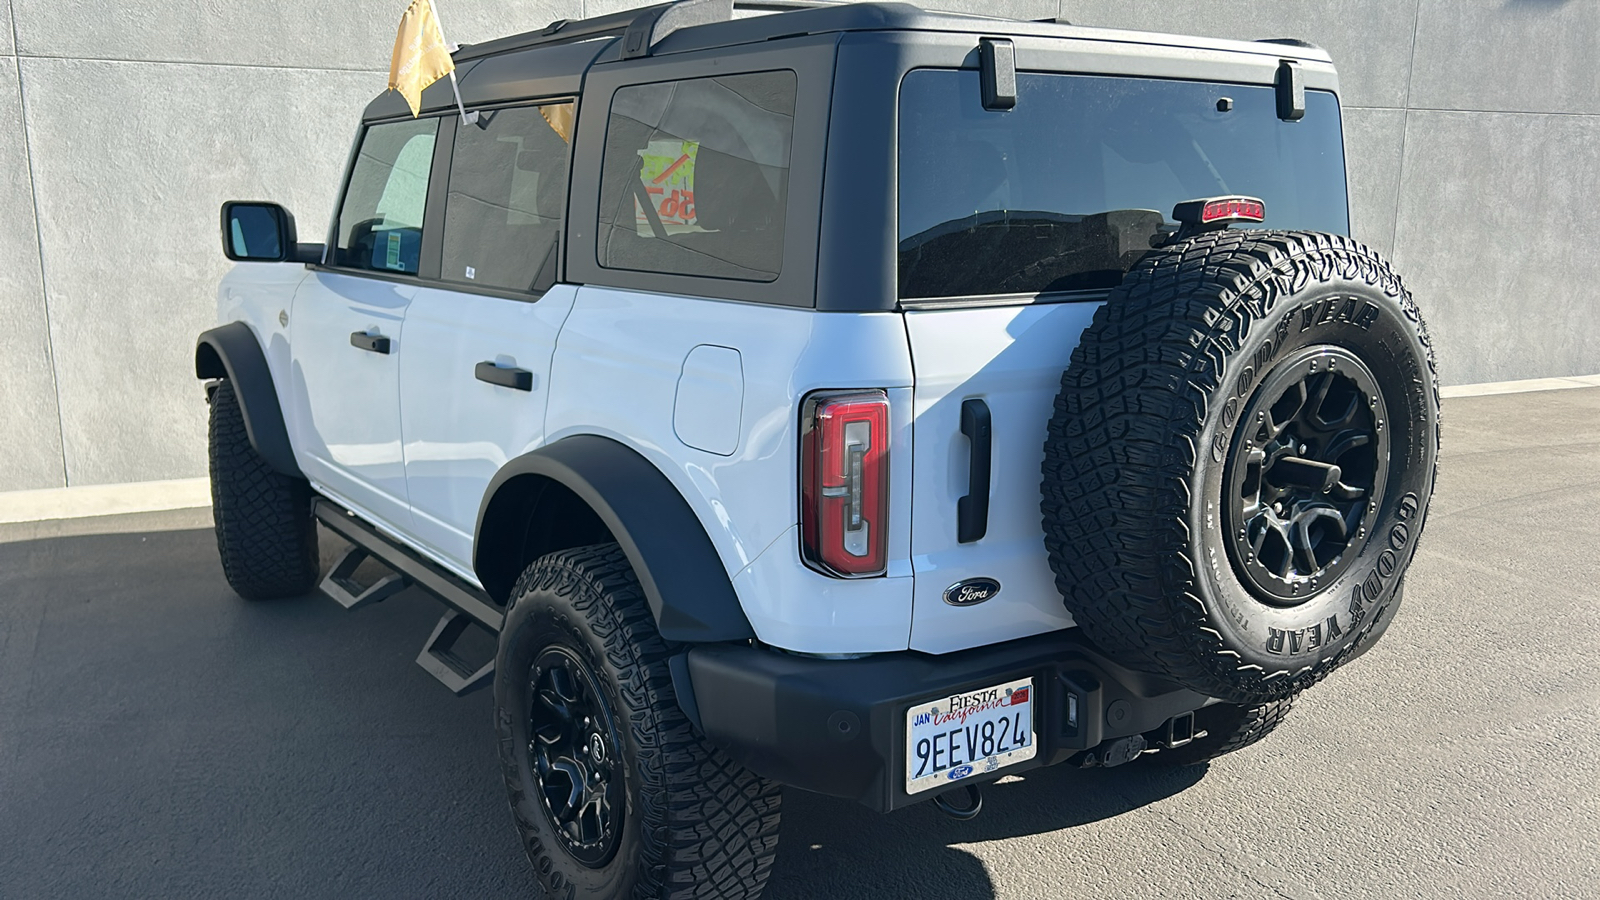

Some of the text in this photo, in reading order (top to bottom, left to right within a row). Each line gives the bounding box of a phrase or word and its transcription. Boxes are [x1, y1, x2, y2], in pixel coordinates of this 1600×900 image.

[949, 689, 998, 713] FIESTA
[914, 713, 931, 727] JAN
[916, 712, 1026, 778] 9EEV824
